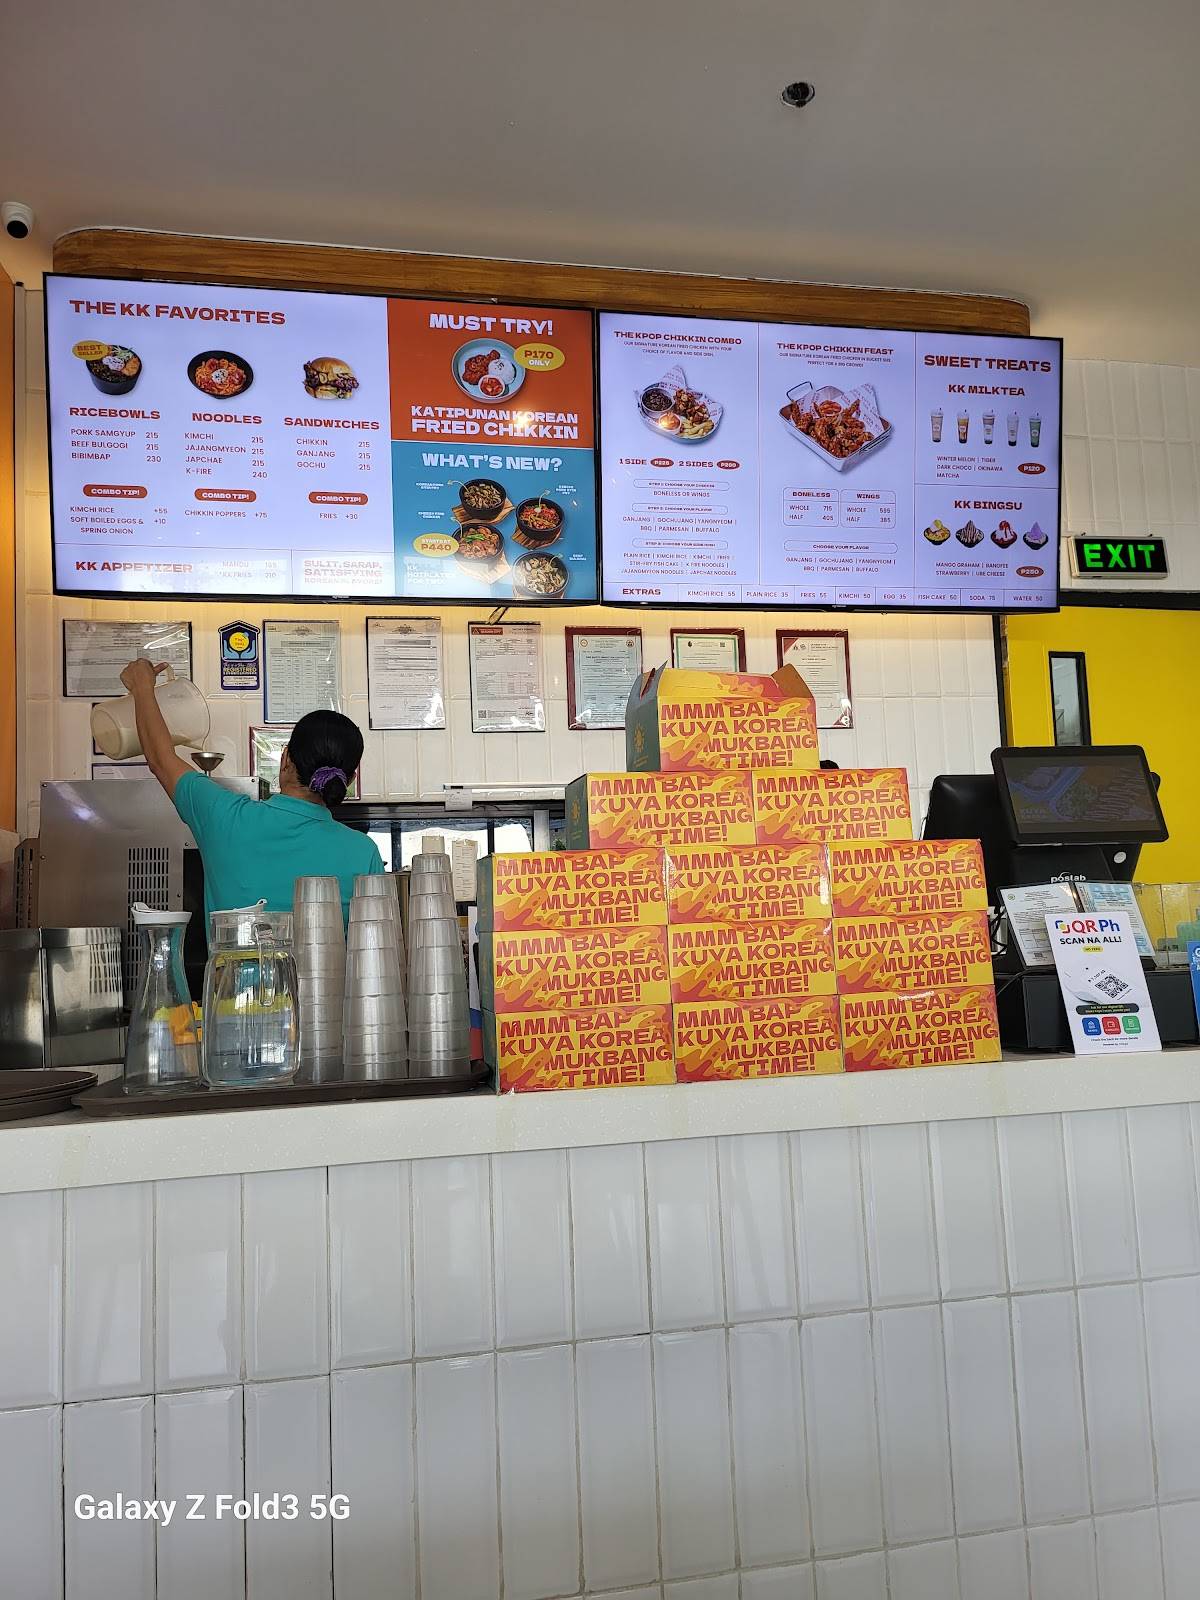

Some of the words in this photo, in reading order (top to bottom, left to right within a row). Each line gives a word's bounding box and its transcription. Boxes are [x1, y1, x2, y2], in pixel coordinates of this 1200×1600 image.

[69, 300, 116, 315] THE
[120, 302, 150, 317] KK
[156, 304, 286, 325] FAVORITES
[430, 314, 496, 332] MUST
[500, 318, 553, 335] TRY!
[524, 350, 554, 359] P170
[924, 355, 981, 368] SWEET
[985, 358, 1051, 372] TREATS
[949, 384, 965, 393] KK
[69, 407, 160, 419] RICEBOWLS
[192, 413, 262, 424] NOODLES
[411, 406, 510, 420] KATIPUNAN
[513, 411, 577, 423] KOREAN
[284, 417, 380, 430] SANDWICHES
[412, 419, 479, 434] FRIED
[484, 424, 578, 439] CHIKKIN
[71, 429, 93, 437] PORK
[95, 429, 136, 438] SAMGYUP
[146, 431, 159, 439] 215
[184, 432, 214, 440] KIMCHI
[251, 436, 264, 444] 215
[296, 438, 328, 446] CHIKKIN
[71, 440, 91, 449] BEEF
[92, 441, 128, 449] BULGOGI
[146, 443, 159, 451] 215
[185, 444, 246, 453] JAJANGMYEON
[296, 450, 336, 458] GANJANG
[71, 452, 110, 461] BIBIMBAP
[146, 455, 161, 463] 230
[185, 456, 223, 464] JAPCHAE
[252, 459, 265, 467] 215
[297, 461, 326, 469] GOCHU
[422, 453, 503, 469] WHAT'S
[506, 457, 562, 471] NEW?
[186, 468, 212, 476] K-FIRE
[252, 471, 267, 479] 240
[91, 488, 120, 496] COMBO
[70, 505, 97, 514] KIMCHI
[954, 500, 971, 509] KK
[974, 501, 1023, 510] BINGSU
[70, 516, 89, 525] SOFT
[91, 517, 115, 525] BOILED
[117, 517, 136, 525] EGGS
[185, 509, 213, 517] CHIKKIN
[215, 510, 246, 519] POPPERS
[254, 511, 267, 519] +75
[319, 512, 337, 520] FRIES
[80, 527, 107, 535] SPRING
[1084, 543, 1154, 568] EXIT
[75, 561, 98, 571] KK
[101, 561, 192, 573] APPETIZER
[661, 704, 723, 720] MMM
[729, 702, 780, 718] BAP
[662, 719, 728, 738] KUYA
[733, 717, 812, 734] KOREA
[702, 735, 817, 753] MUKBANG
[721, 752, 793, 769] TIME!
[591, 779, 656, 796] MMM
[662, 776, 714, 793] BAP
[757, 776, 818, 793] MMM
[824, 773, 874, 790] BAP
[591, 795, 660, 814] KUYA
[667, 792, 750, 809] KOREA
[757, 793, 823, 811] KUYA
[829, 789, 908, 807] KOREA
[634, 809, 753, 829] MUKBANG
[798, 806, 910, 826] MUKBANG
[653, 825, 727, 846] TIME!
[816, 821, 887, 841] TIME!
[497, 857, 565, 876] MMM
[572, 853, 629, 871] BAP
[497, 876, 570, 895] KUYA
[576, 871, 660, 889] KOREA
[541, 888, 666, 911] MUKBANG
[559, 905, 639, 927] TIME!
[501, 1016, 570, 1038] MMM
[576, 1012, 634, 1030] BAP
[501, 1036, 574, 1057] KUYA
[580, 1028, 666, 1049] KOREA
[544, 1046, 672, 1071] MUKBANG
[562, 1064, 645, 1088] TIME!
